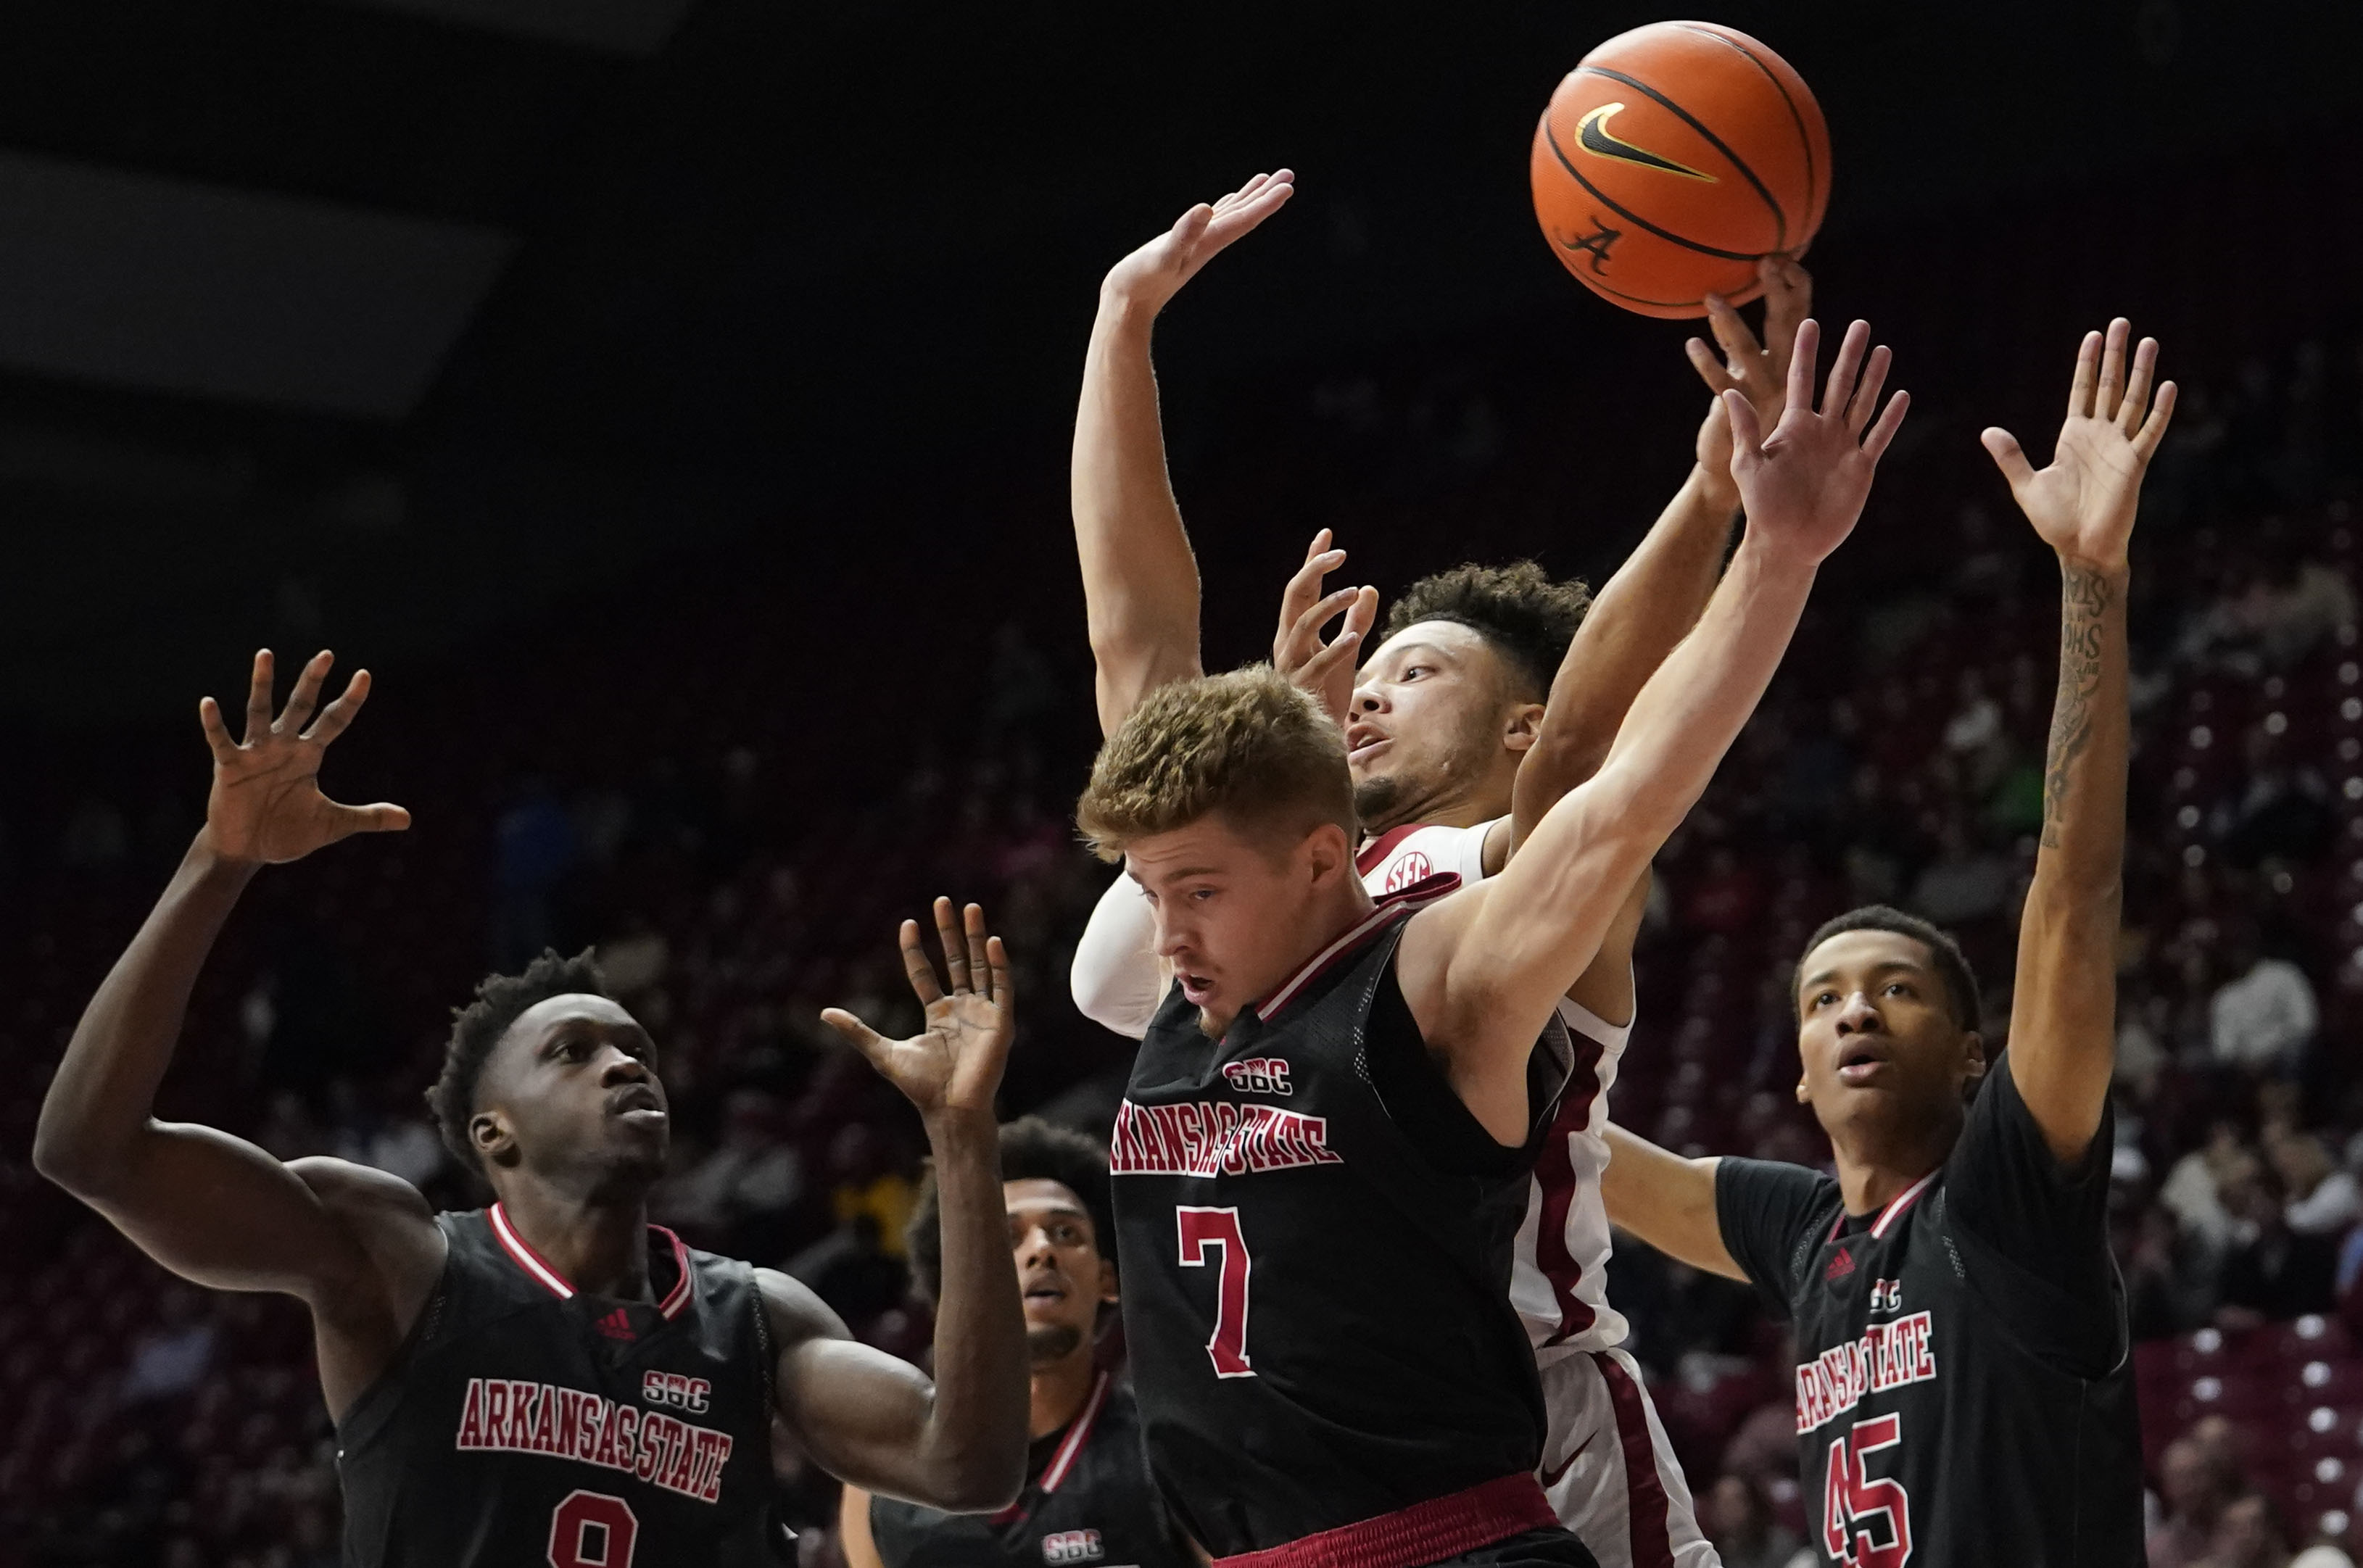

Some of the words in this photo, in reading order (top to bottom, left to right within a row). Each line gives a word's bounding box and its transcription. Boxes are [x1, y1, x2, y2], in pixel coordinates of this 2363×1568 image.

[1222, 1058, 1293, 1096] SBC
[1221, 1103, 1344, 1176] STATE
[1176, 1205, 1258, 1379] 7
[456, 1377, 640, 1472] ARKANSAS
[635, 1411, 733, 1504] STATE
[642, 1369, 711, 1414] SBC
[1823, 1411, 1913, 1568] 45
